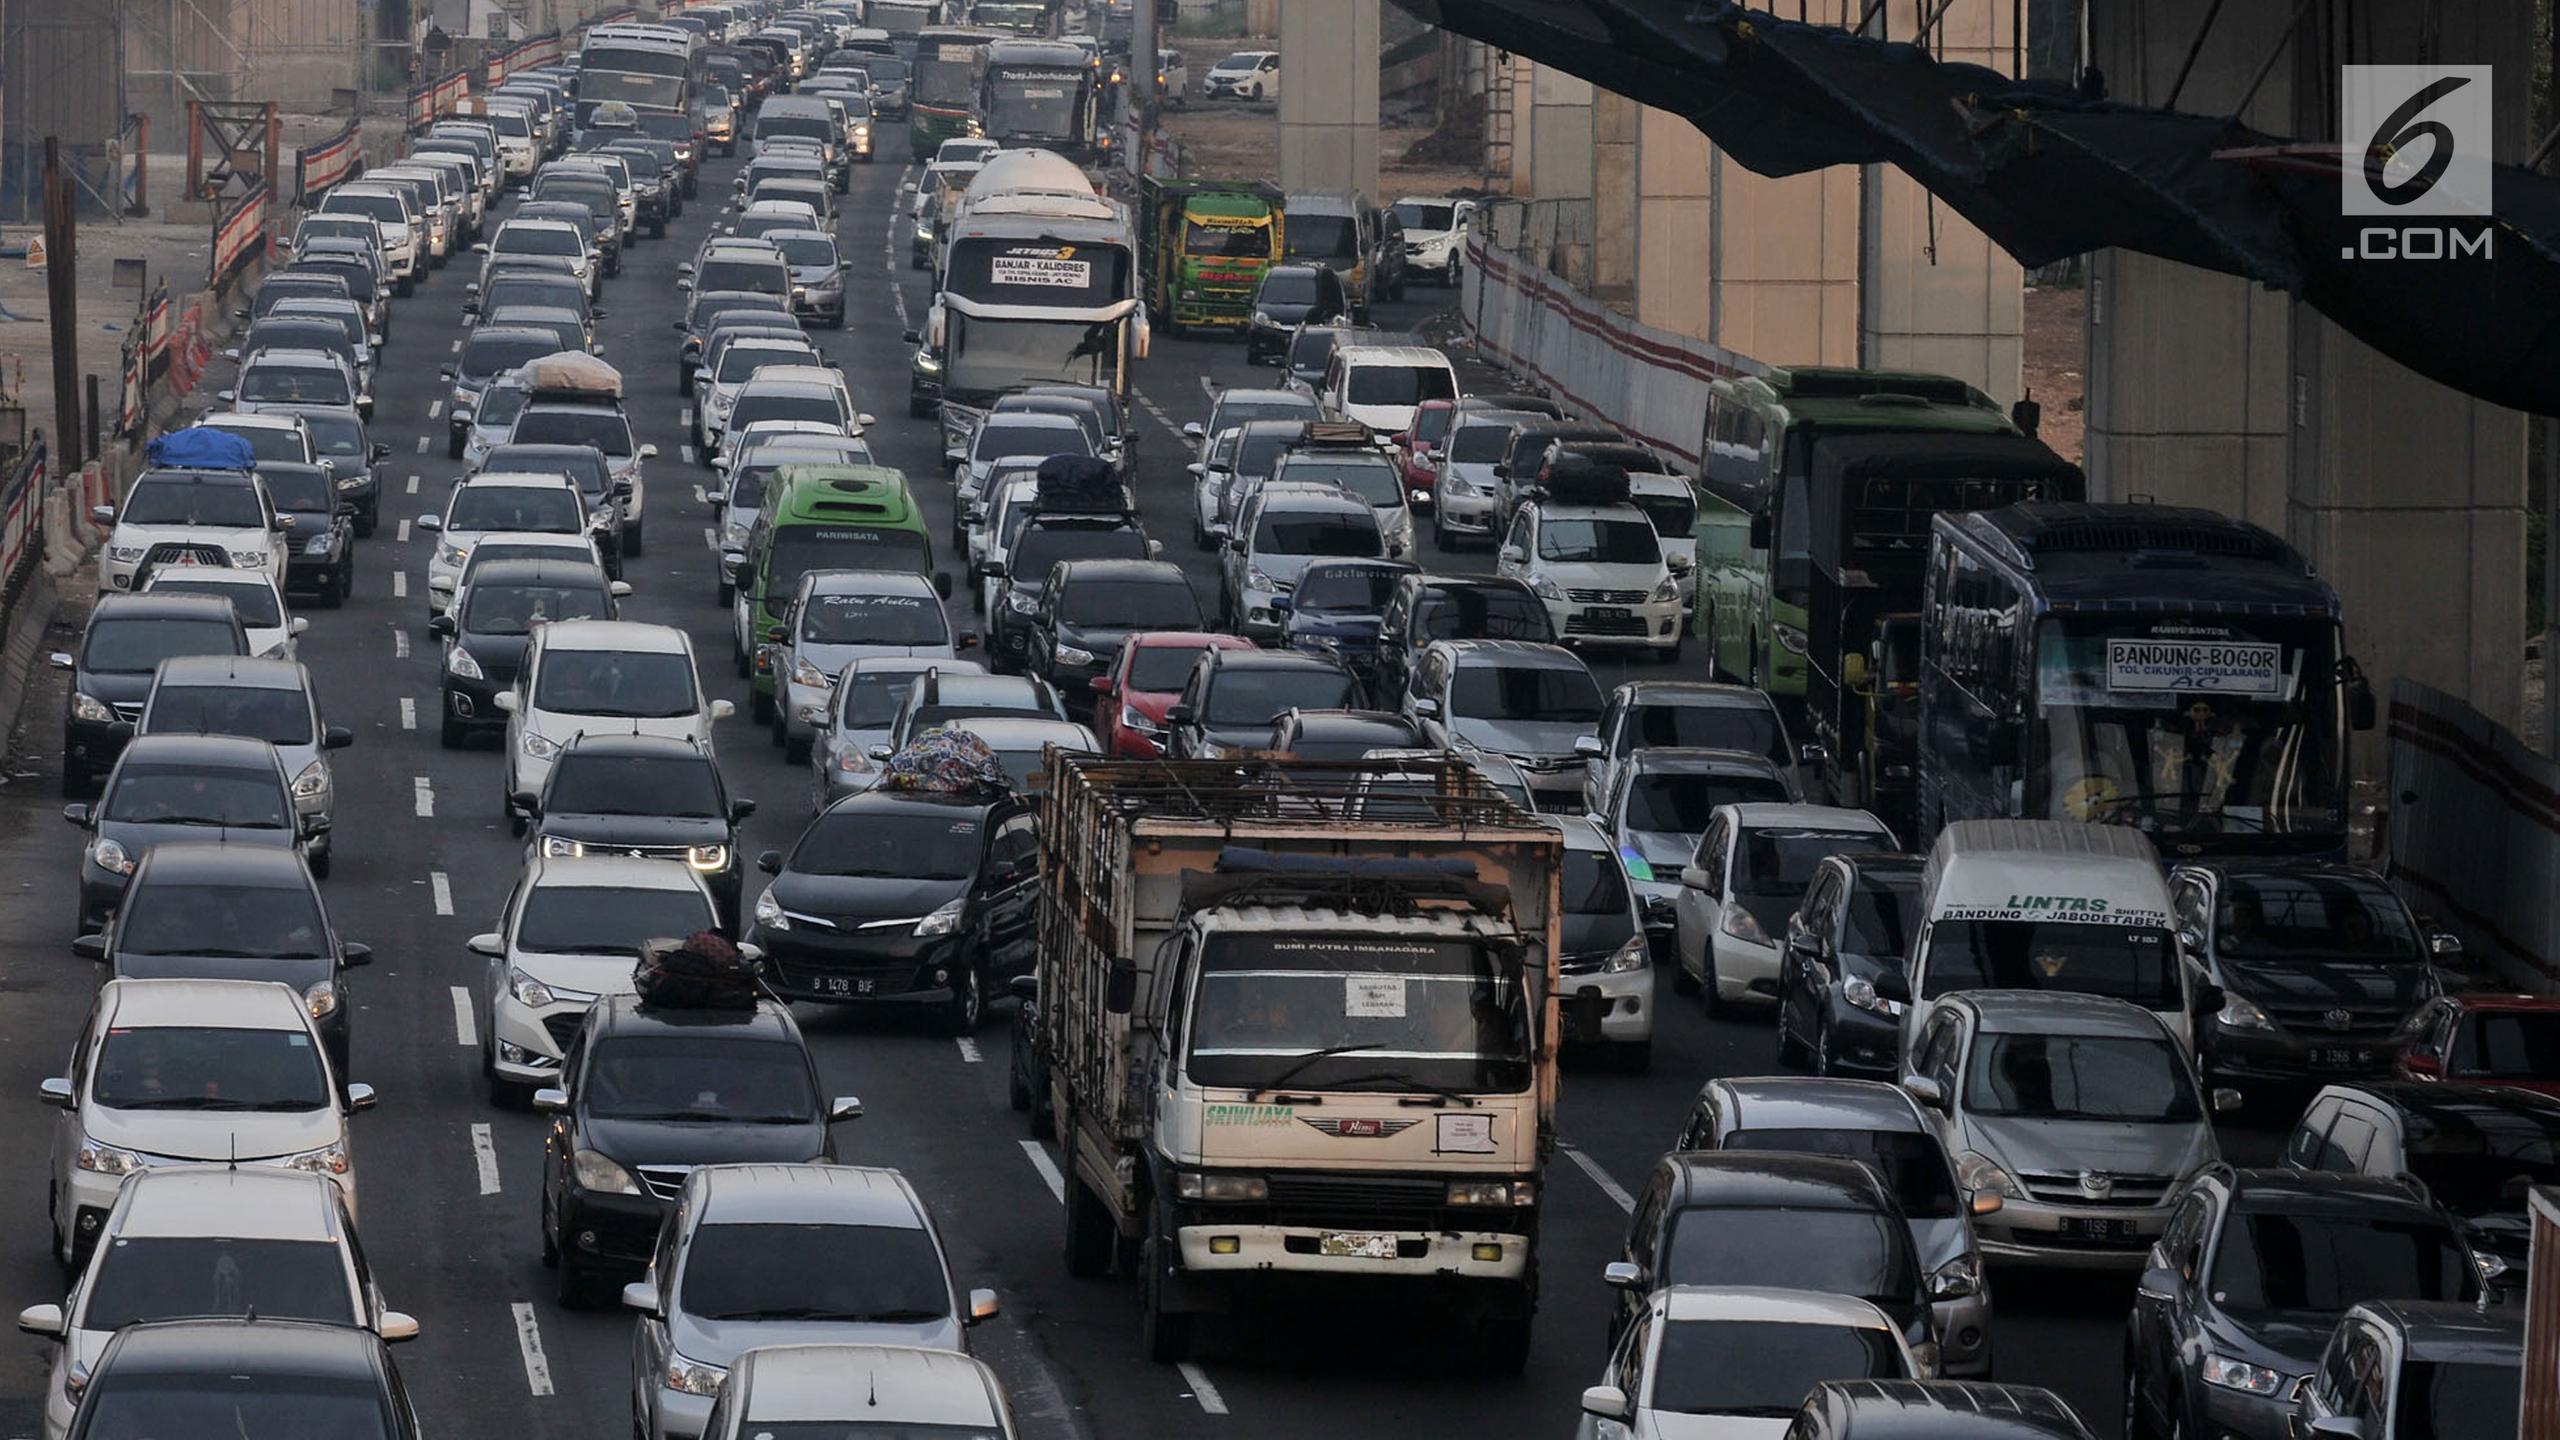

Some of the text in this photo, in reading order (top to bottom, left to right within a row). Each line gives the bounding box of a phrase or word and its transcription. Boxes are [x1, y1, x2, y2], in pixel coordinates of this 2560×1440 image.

[995, 260, 1030, 270] BANJAR
[1037, 262, 1085, 273] KALIDERES
[816, 531, 880, 541] PARIWISATA
[823, 596, 920, 608] Ratu Aulia
[2113, 647, 2274, 669] BANDUNG-BOGOR
[2117, 665, 2139, 675] TOL
[2170, 676, 2219, 688] AC
[2007, 895, 2108, 912] LINTAS
[1943, 910, 2166, 928] BANDUNG JABODETABEK
[2115, 908, 2166, 918] SHUTTLE
[1206, 1105, 1294, 1126] SRIWIJAYA
[1346, 1121, 1377, 1134] Hino
